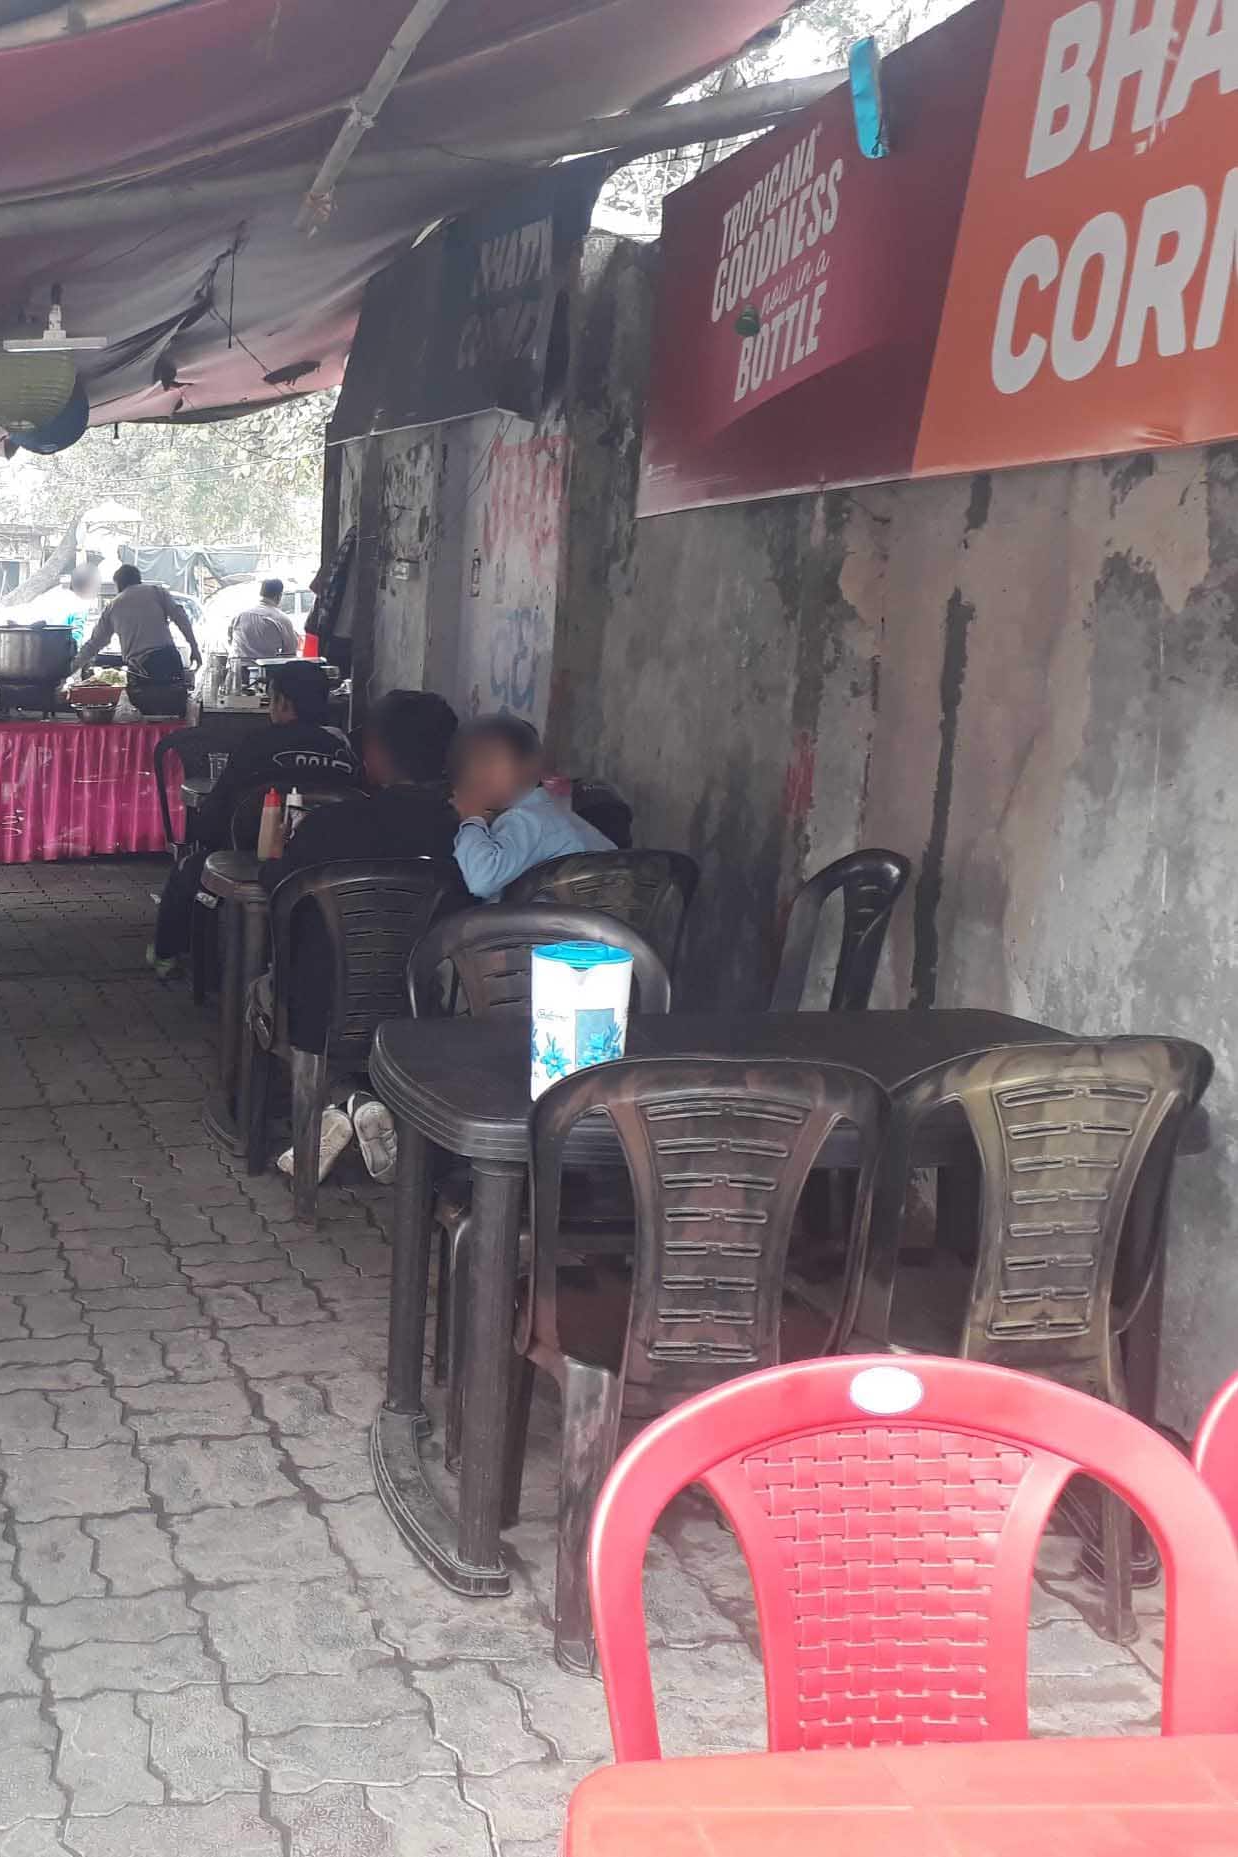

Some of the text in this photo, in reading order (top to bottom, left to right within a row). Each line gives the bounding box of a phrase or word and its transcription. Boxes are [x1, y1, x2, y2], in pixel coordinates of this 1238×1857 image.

[711, 158, 843, 322] GOODNESS
[720, 128, 818, 258] TROPICANA
[734, 280, 827, 403] BOTTLE
[762, 249, 831, 319] now in a
